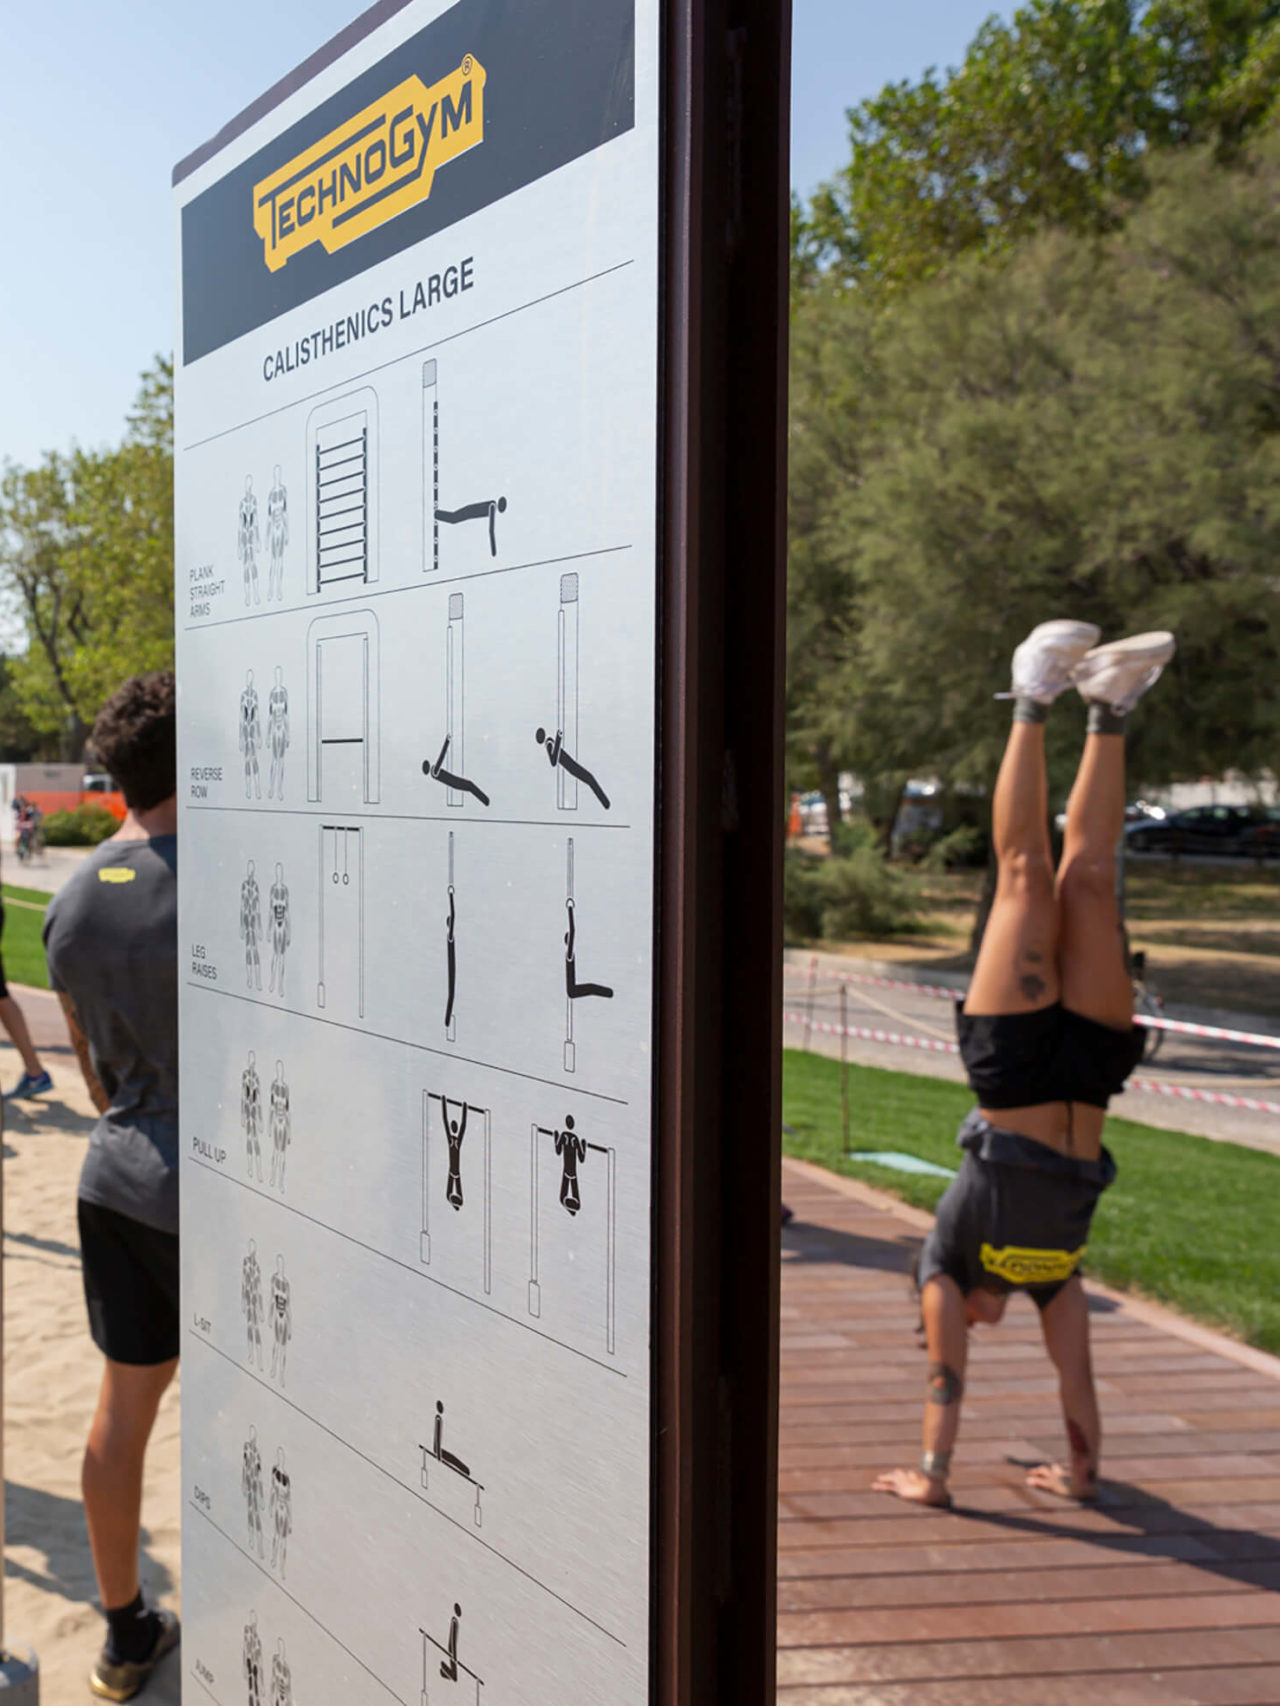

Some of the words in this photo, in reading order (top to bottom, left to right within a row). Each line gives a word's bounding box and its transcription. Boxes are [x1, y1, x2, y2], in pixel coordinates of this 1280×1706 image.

[263, 297, 394, 382] CALISTHENICS
[400, 257, 474, 320] LARGE
[189, 565, 214, 582] PLANK
[189, 580, 225, 601] STRAIGHT
[190, 602, 211, 618] ARMS
[191, 767, 223, 782] REVERSE
[191, 785, 208, 799] ROW
[192, 944, 206, 959] LEG
[192, 962, 217, 980] RAISES
[192, 1137, 213, 1160] PULL
[214, 1149, 227, 1164] UP
